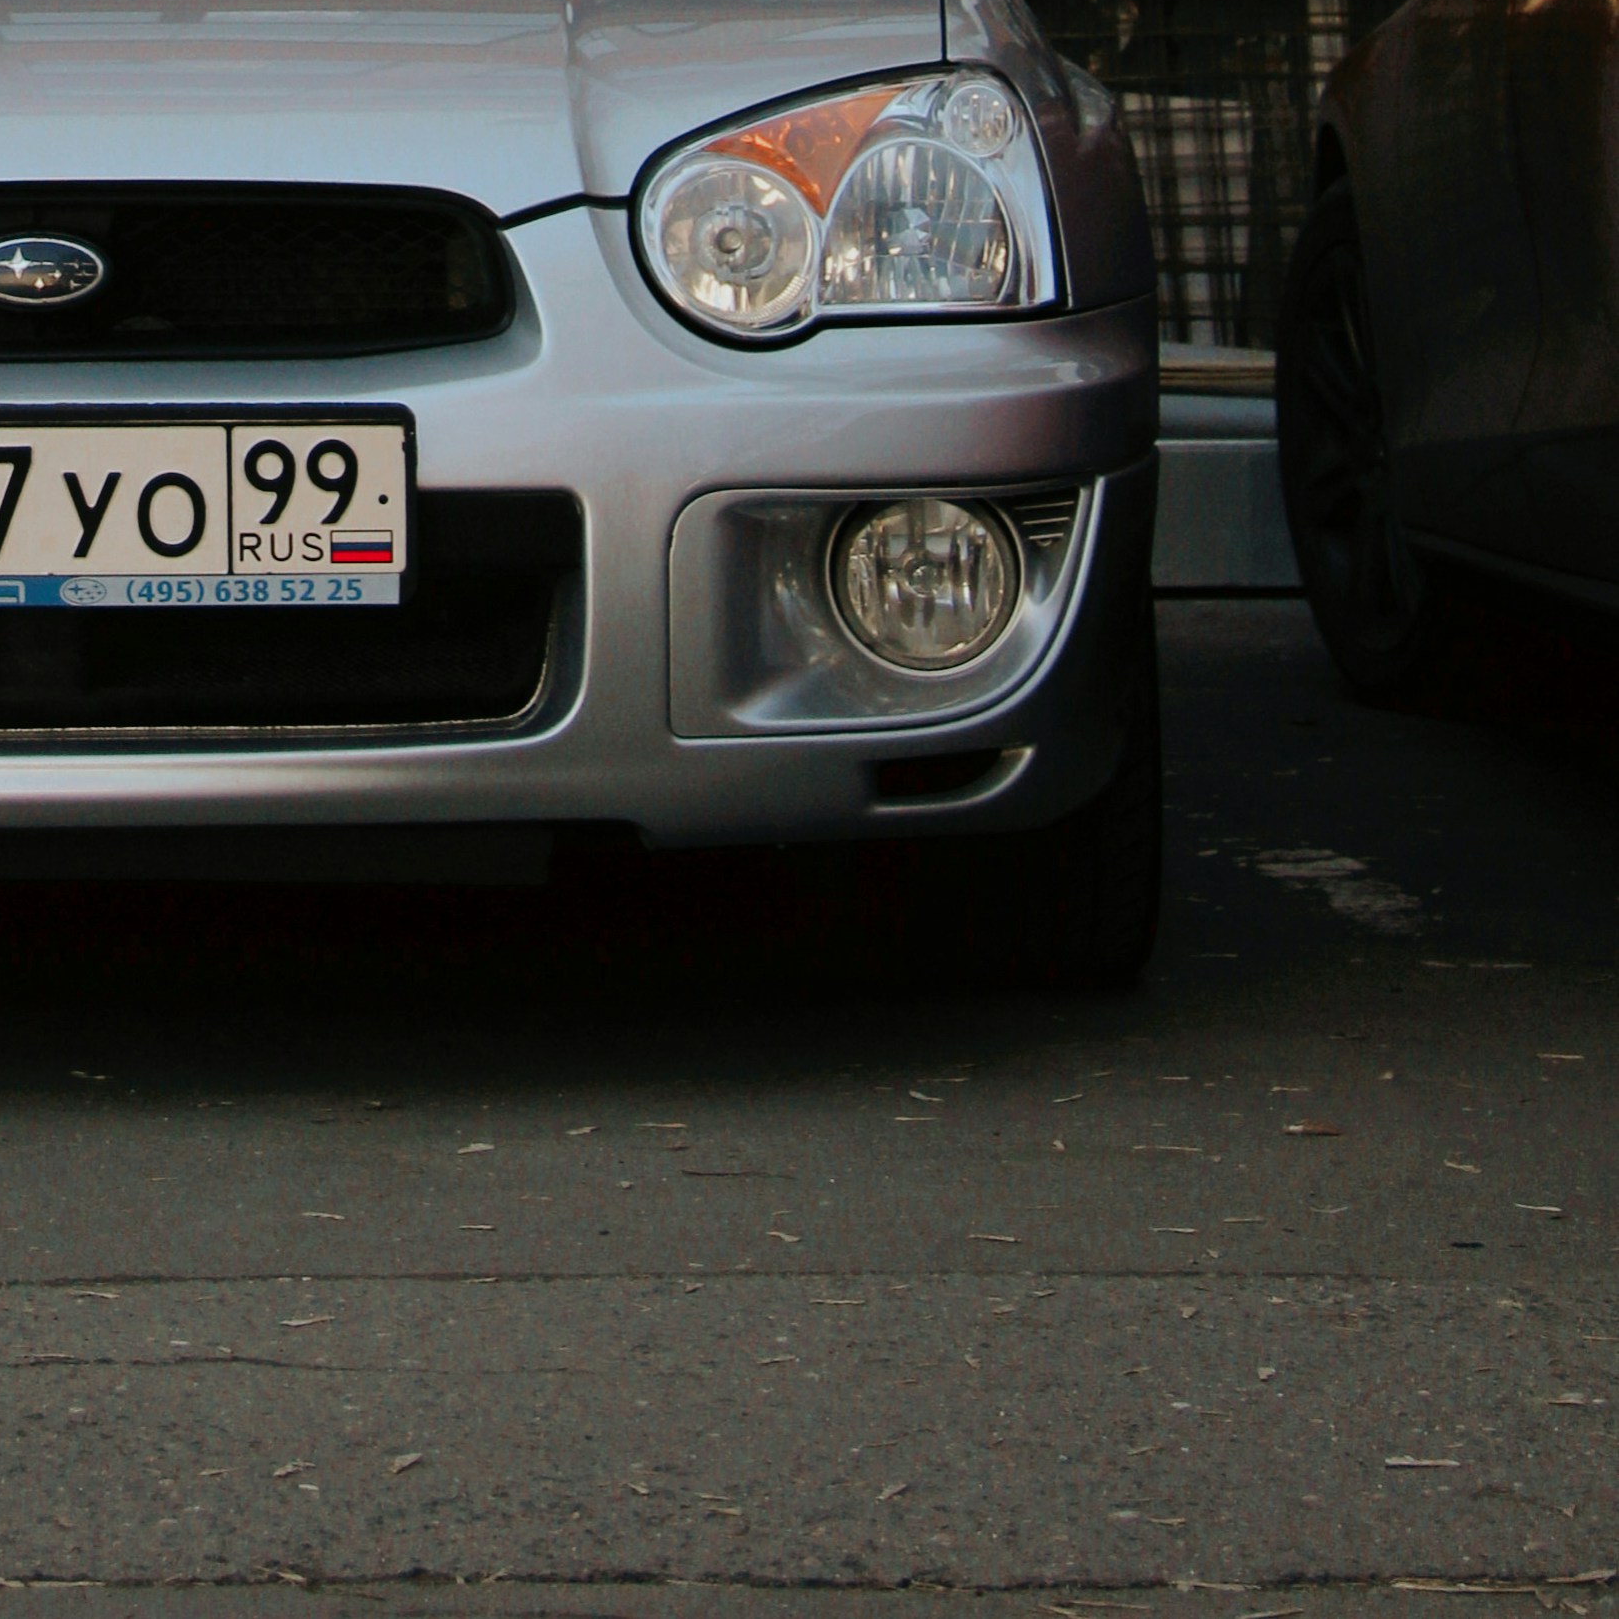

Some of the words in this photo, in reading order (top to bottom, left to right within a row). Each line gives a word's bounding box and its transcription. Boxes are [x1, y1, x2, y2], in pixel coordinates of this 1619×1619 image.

[243, 439, 359, 525] 99
[239, 532, 324, 562] RUS
[126, 579, 205, 604] (495)
[214, 579, 270, 603] 638
[280, 579, 316, 602] 52
[326, 578, 363, 602] 25
